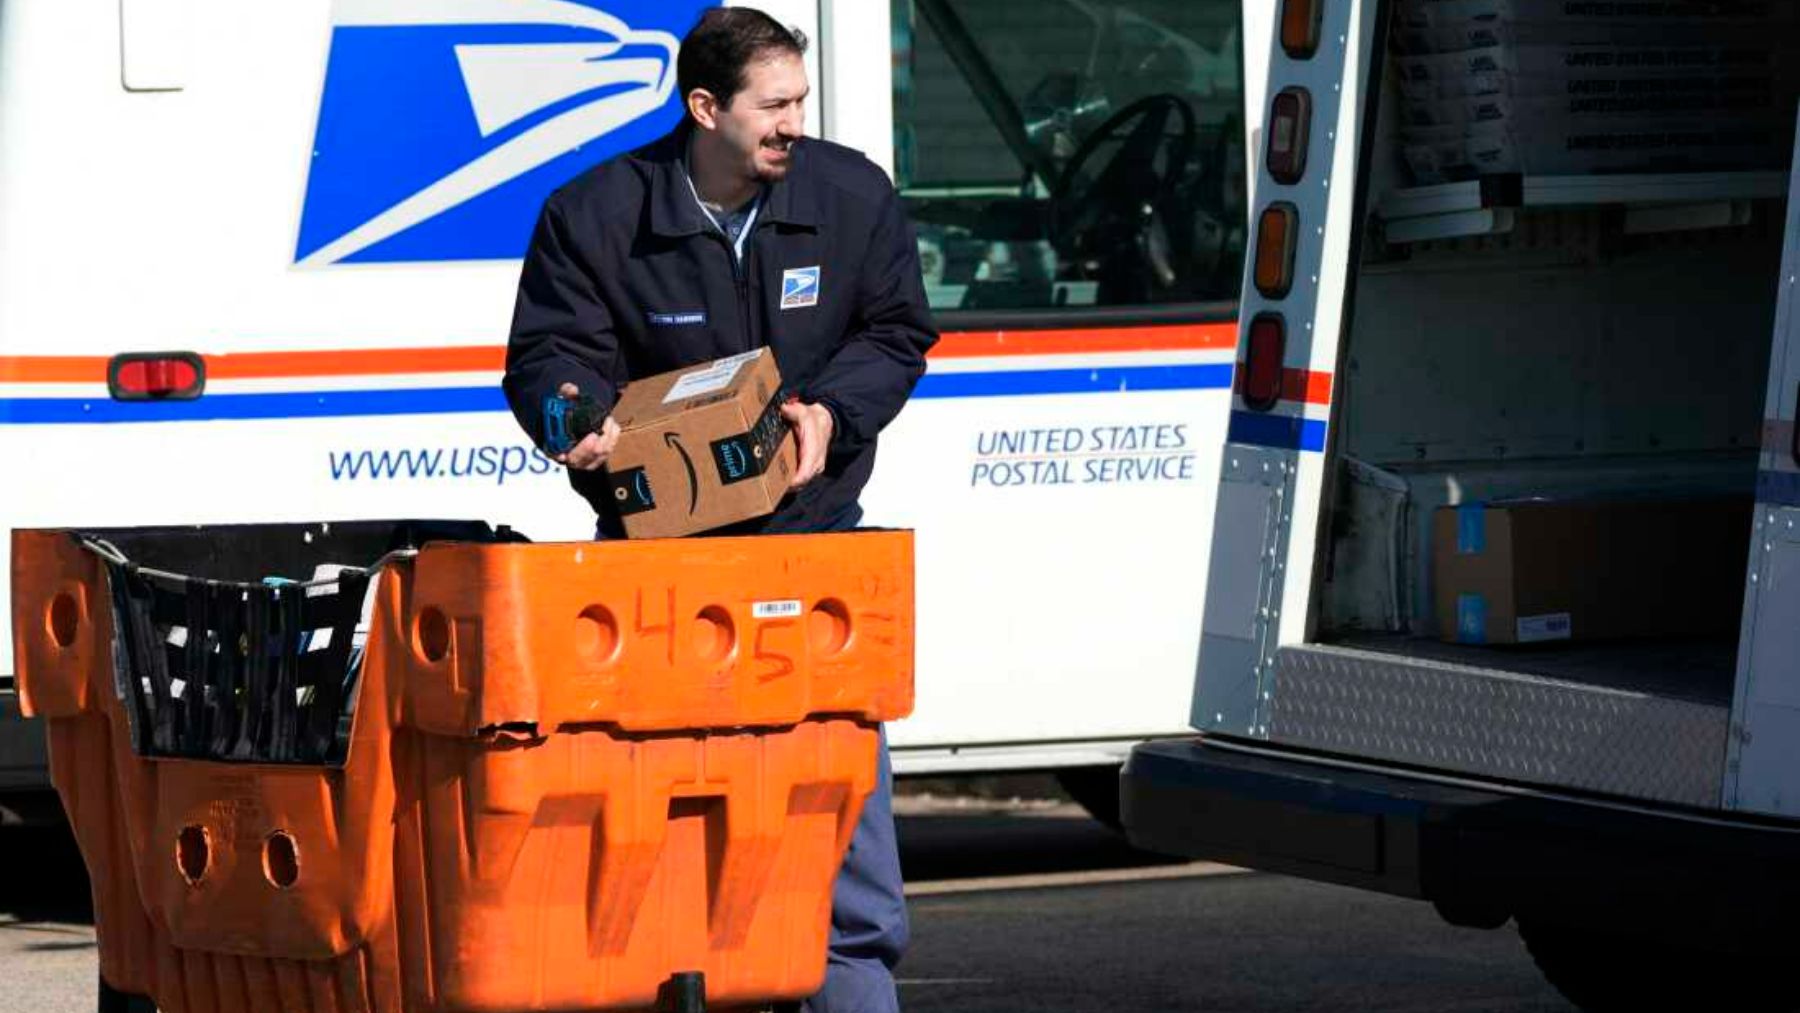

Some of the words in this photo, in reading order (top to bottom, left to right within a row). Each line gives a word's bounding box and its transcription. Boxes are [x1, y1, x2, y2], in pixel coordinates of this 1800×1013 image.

[977, 428, 1084, 456] UNITED
[1089, 424, 1188, 451] STATES
[971, 460, 1076, 487] POSTAL
[1082, 454, 1196, 483] SERVICE
[635, 587, 676, 667] 4
[755, 619, 795, 684] 5
